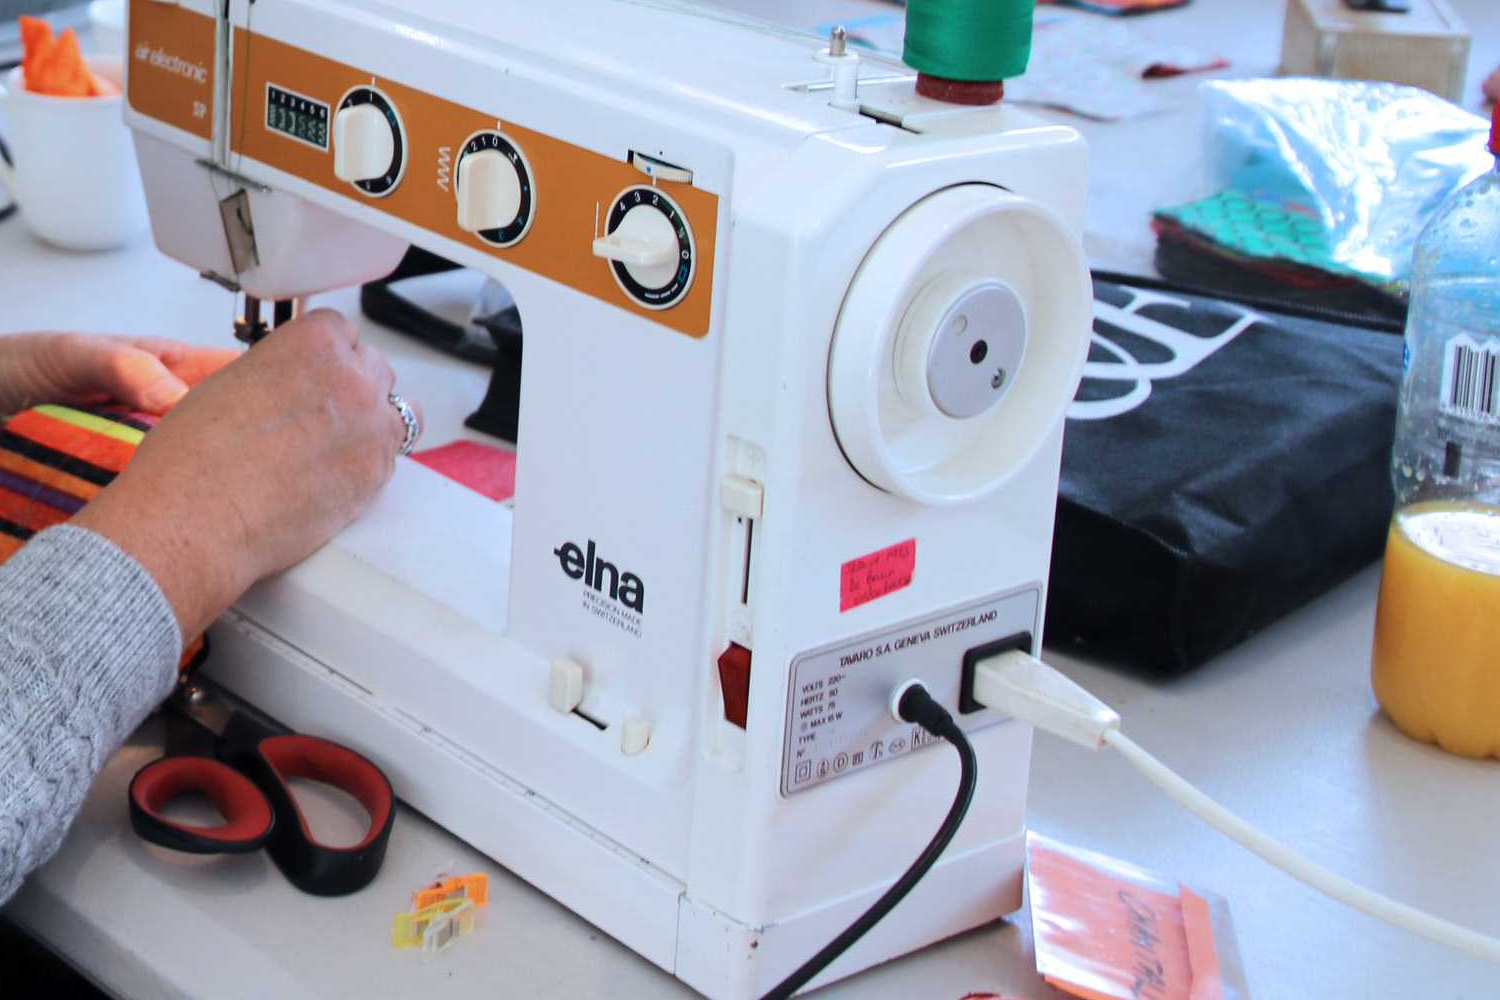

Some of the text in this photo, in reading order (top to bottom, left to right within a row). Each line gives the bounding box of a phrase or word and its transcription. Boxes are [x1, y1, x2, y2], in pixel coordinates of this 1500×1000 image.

[149, 48, 207, 84] electronic
[470, 140, 478, 152] 2
[634, 191, 641, 202] 3
[652, 195, 659, 206] 2
[554, 539, 644, 614] elna
[839, 649, 873, 667] TAVARO
[894, 631, 930, 650] GENEVA
[933, 610, 998, 639] SWITZERLAND
[803, 680, 823, 694] VOLTS
[800, 692, 824, 706] HERTZ
